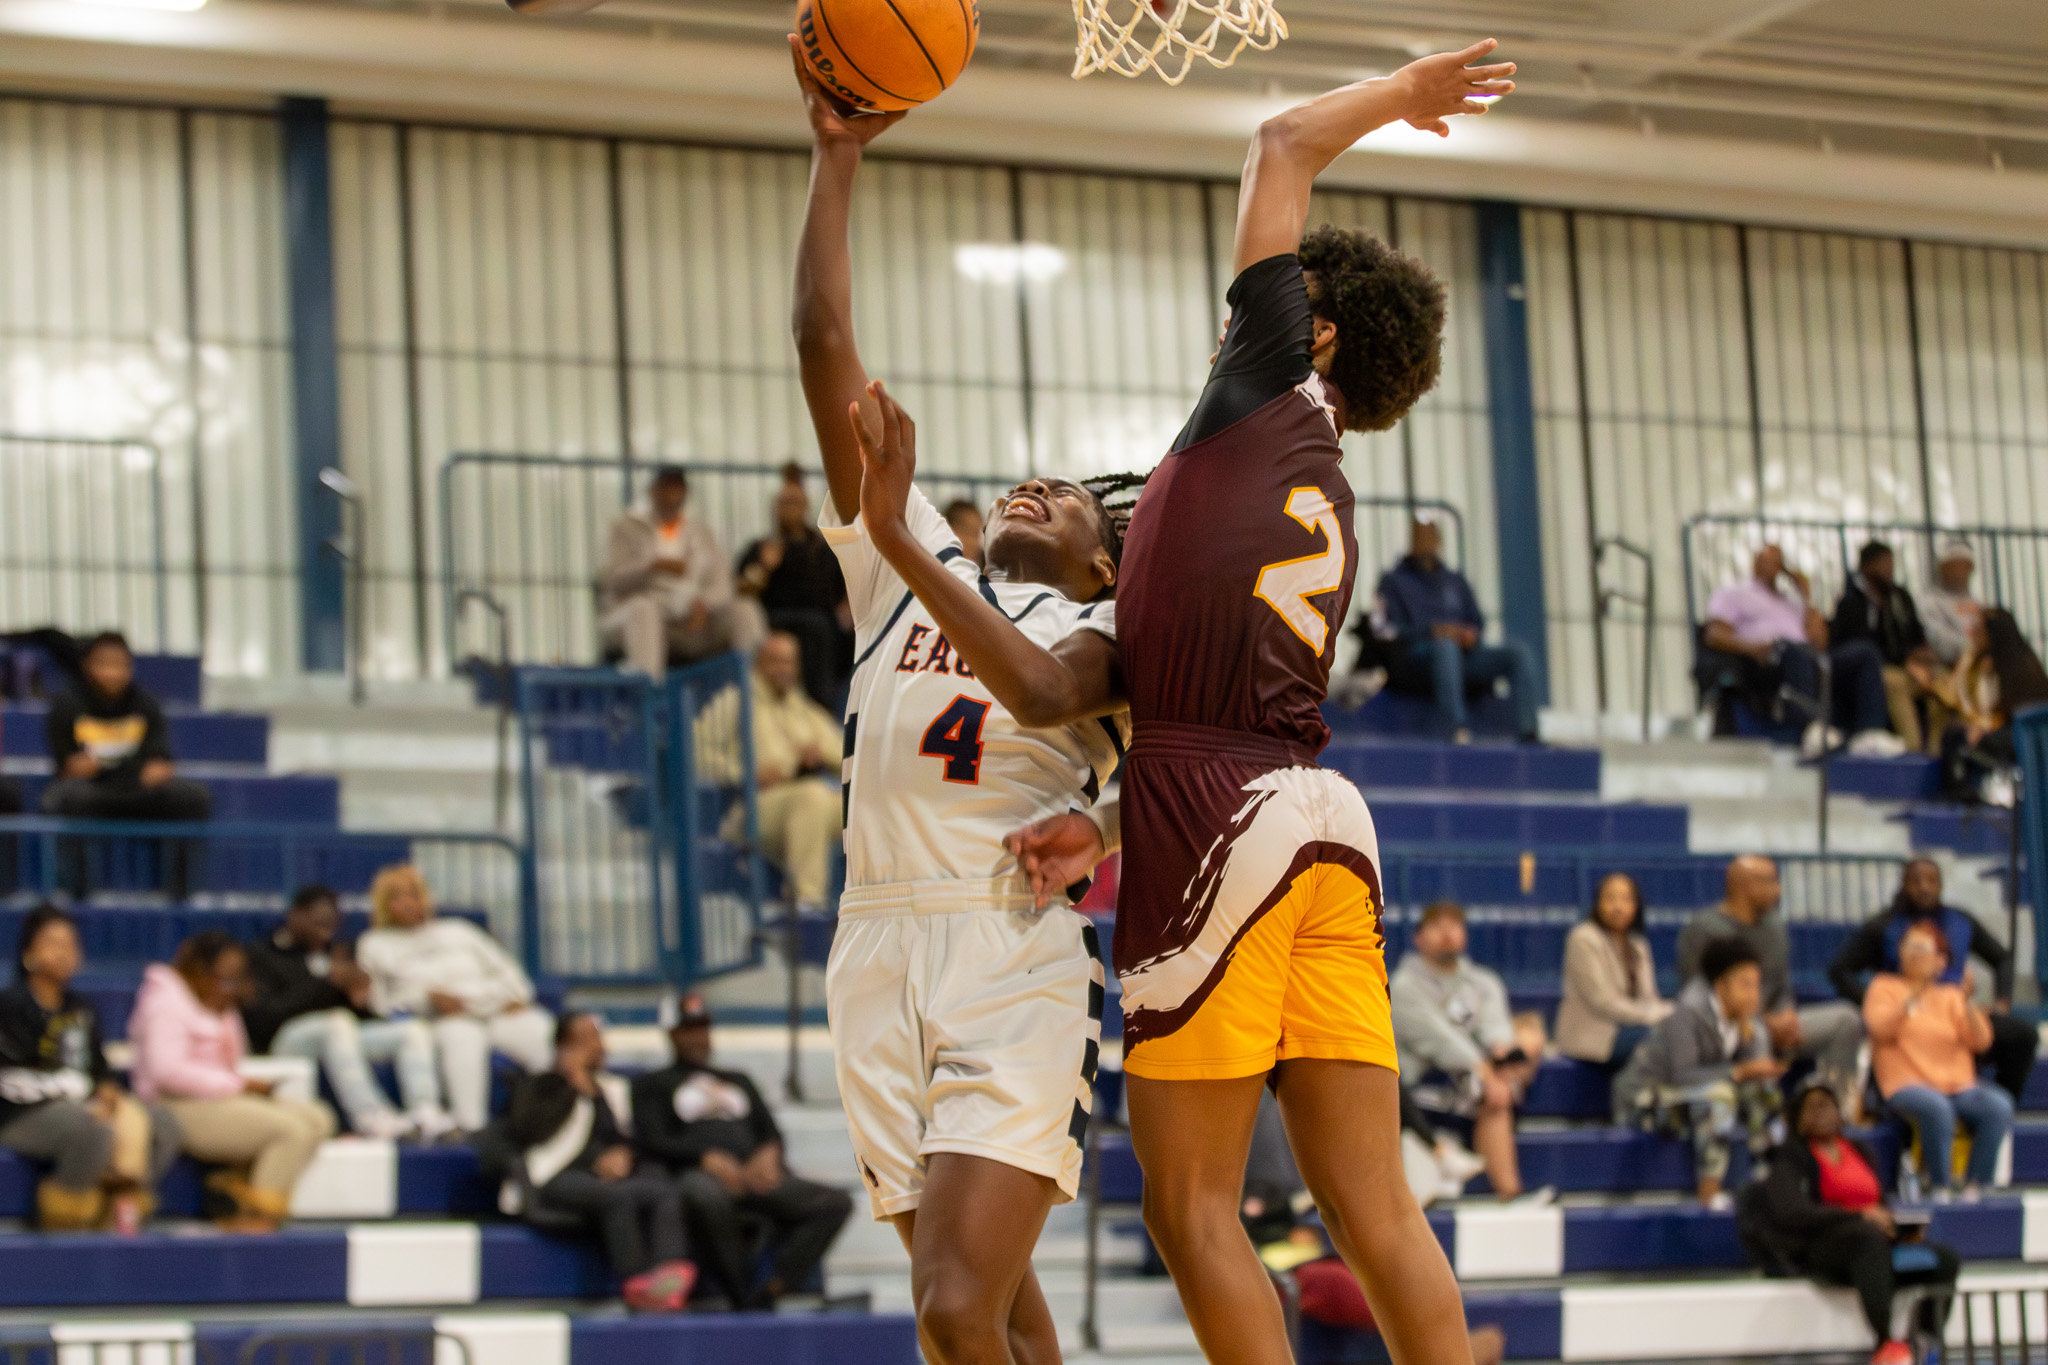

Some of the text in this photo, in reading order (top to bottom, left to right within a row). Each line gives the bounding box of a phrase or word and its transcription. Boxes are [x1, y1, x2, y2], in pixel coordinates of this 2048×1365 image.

[800, 6, 876, 107] Wilson
[1253, 486, 1346, 658] 2
[918, 693, 993, 786] 4
